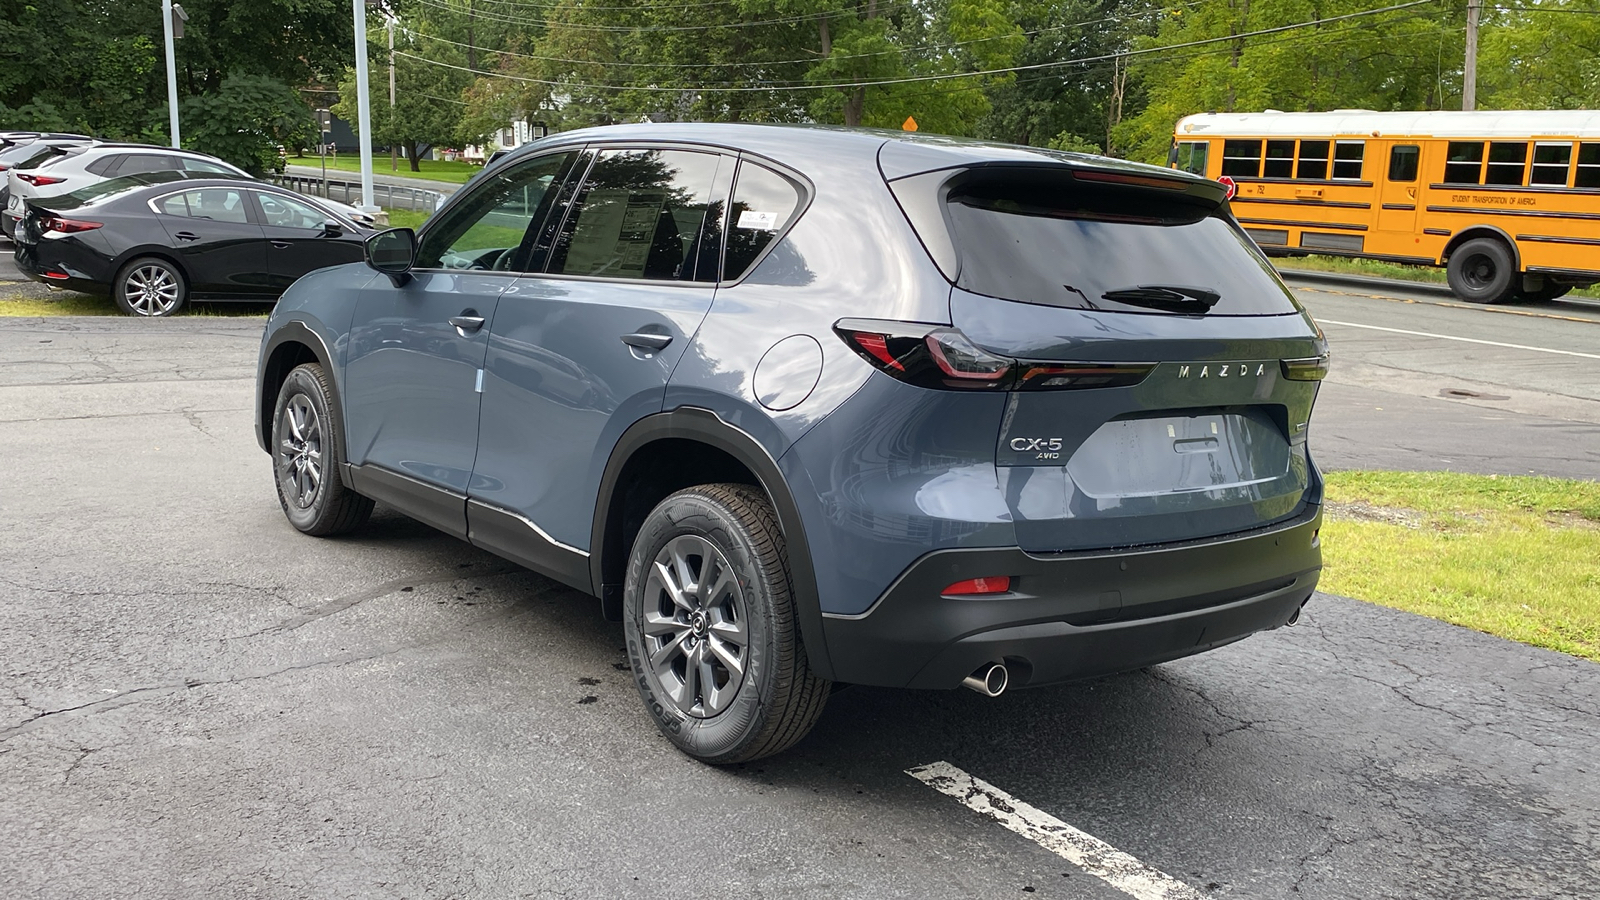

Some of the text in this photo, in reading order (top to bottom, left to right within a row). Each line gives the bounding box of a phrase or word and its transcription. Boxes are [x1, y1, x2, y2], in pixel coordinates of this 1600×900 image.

[1452, 195, 1470, 203] STUDENT
[1472, 196, 1507, 205] TRANSPORTATION
[1509, 197, 1516, 205] OF
[1178, 363, 1265, 378] MAZDA
[1010, 437, 1063, 451] CX-5
[1035, 452, 1060, 460] AWD
[744, 579, 761, 686] YOKOHAMA
